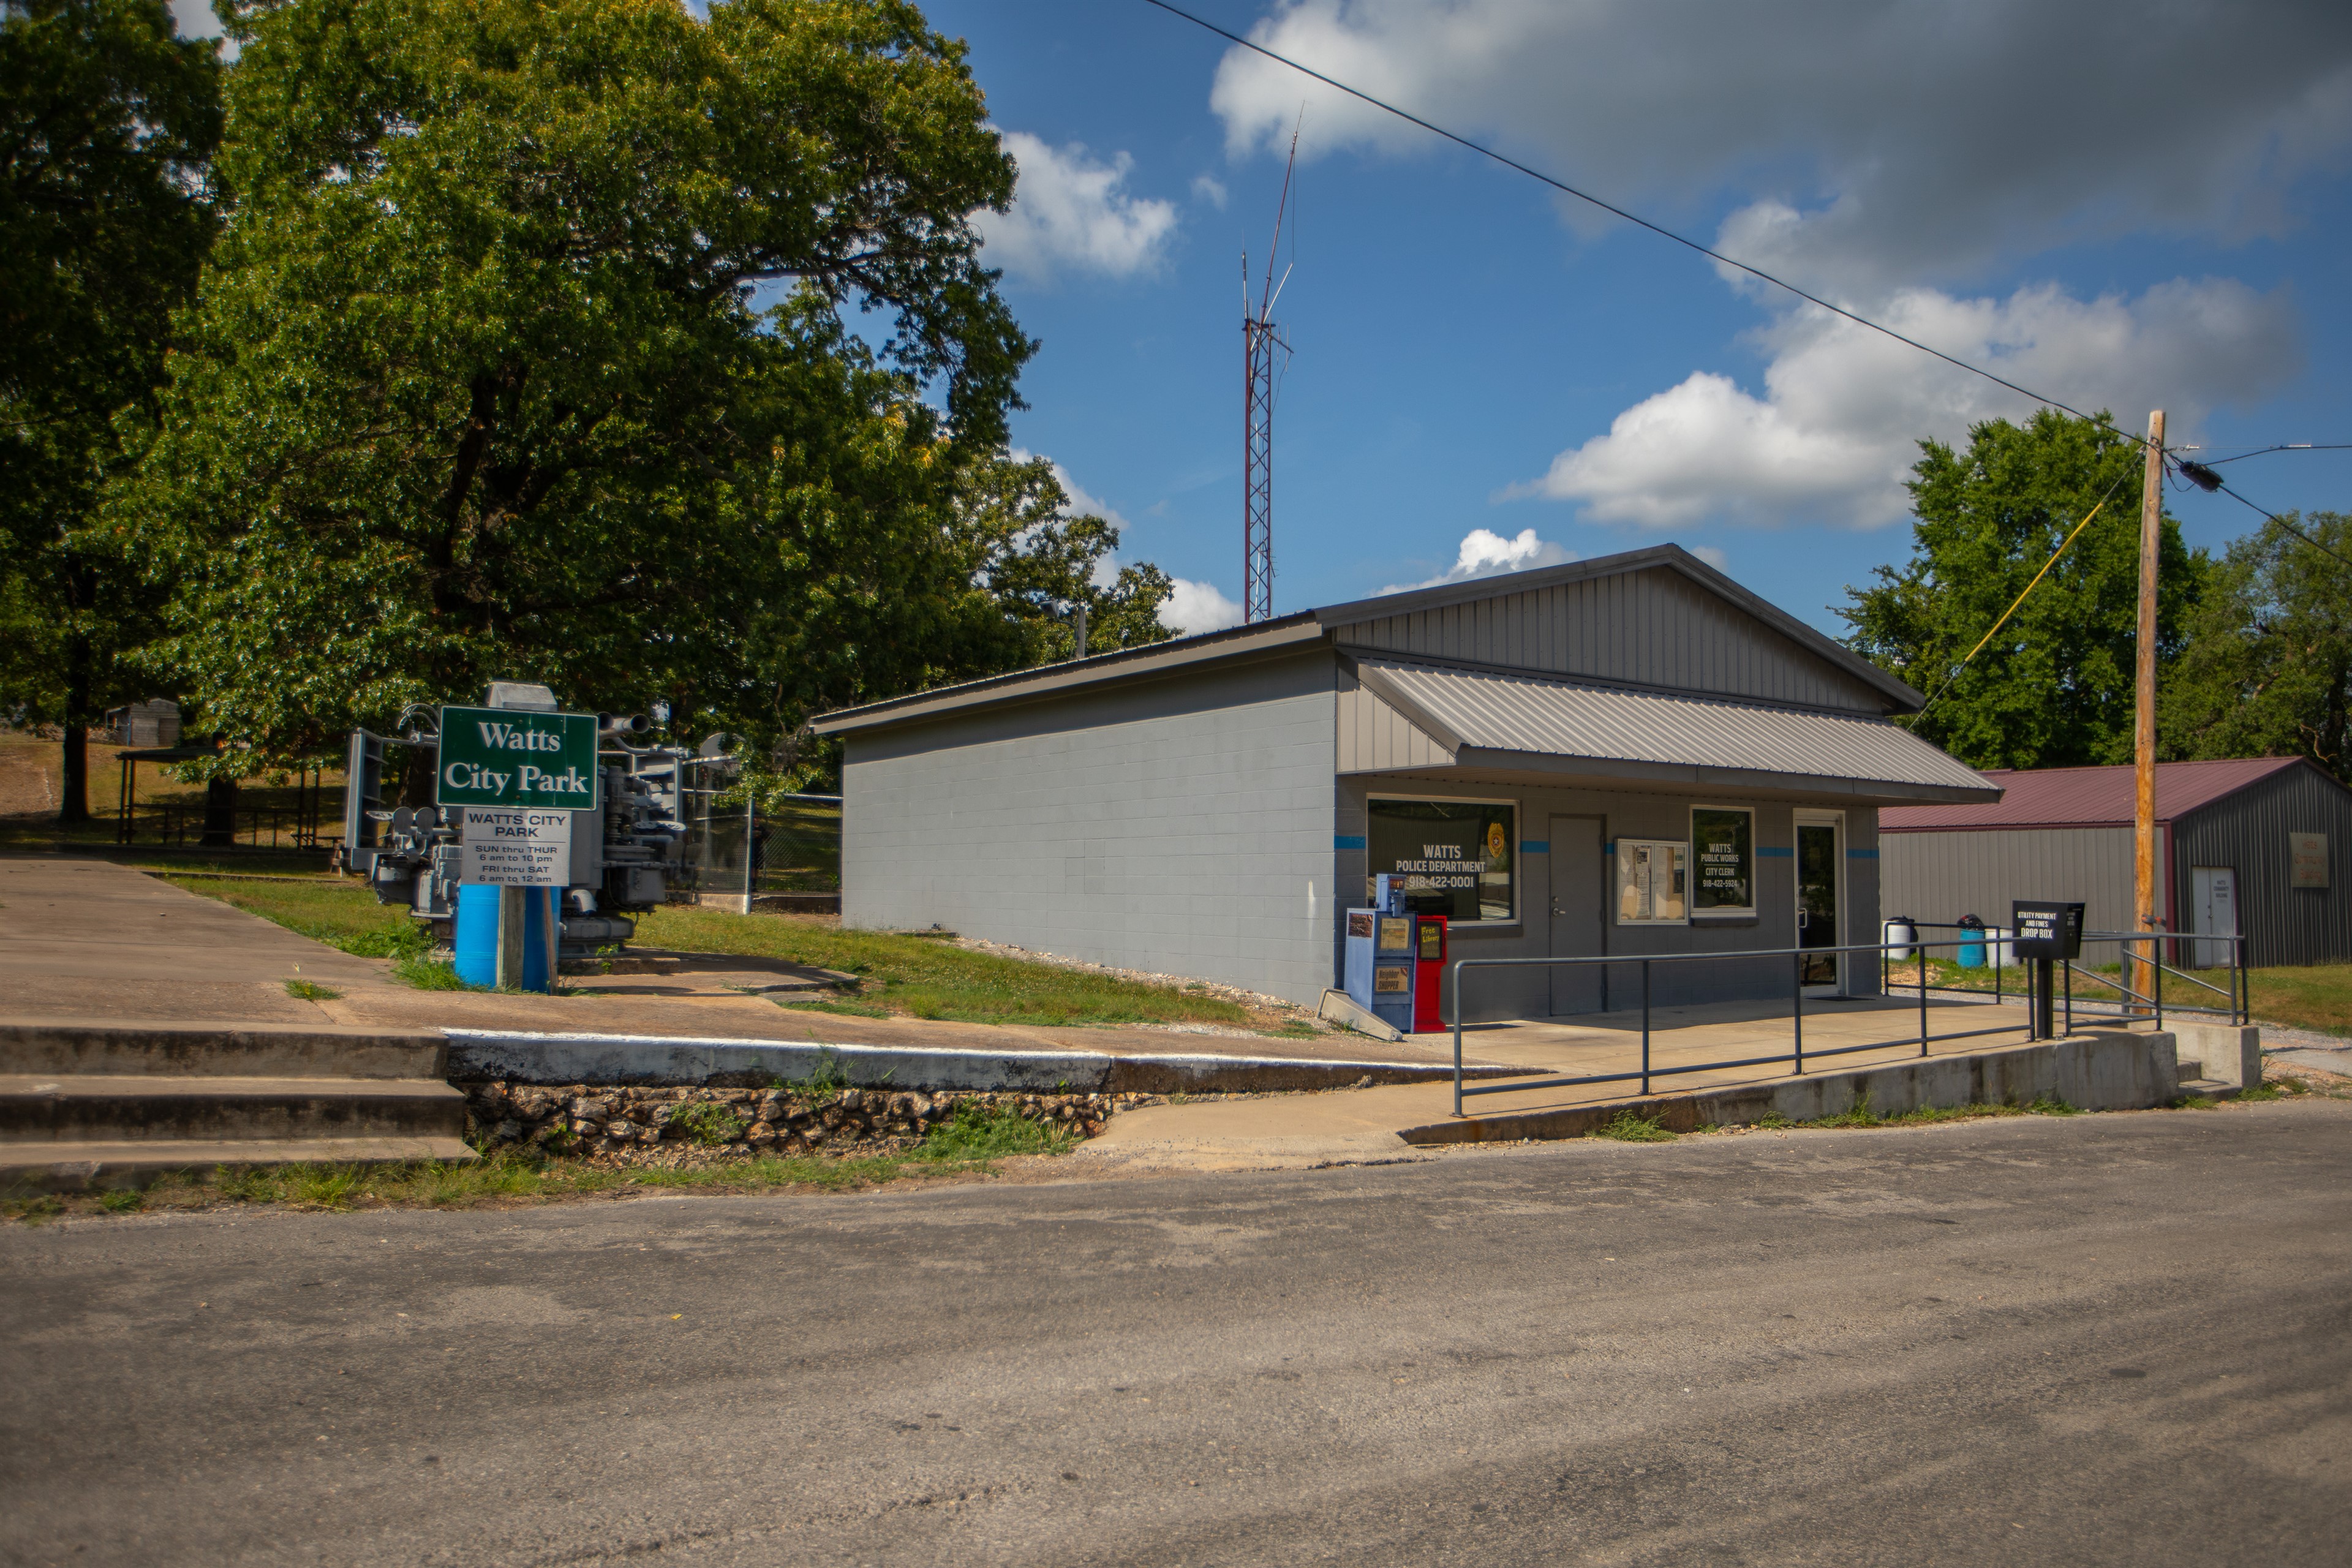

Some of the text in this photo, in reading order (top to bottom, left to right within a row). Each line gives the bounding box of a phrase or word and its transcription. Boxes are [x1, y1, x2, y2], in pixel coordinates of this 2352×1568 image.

[478, 722, 560, 752] Watts
[445, 762, 589, 796] City Park
[469, 813, 567, 826] WATTS CITY
[495, 827, 539, 837] PARK
[1423, 844, 1461, 859] WATTS
[1708, 843, 1732, 853] WATTS
[1396, 860, 1486, 873] POLICE DEPARTMENT
[1705, 867, 1718, 876] CITY
[1409, 875, 1474, 888] 918-422-0001
[1421, 925, 1436, 935] Free
[2021, 927, 2052, 939] DROP BOX
[1422, 935, 1439, 943] Library
[1378, 970, 1400, 980] Neighbor
[1378, 981, 1399, 990] SHOPPER
